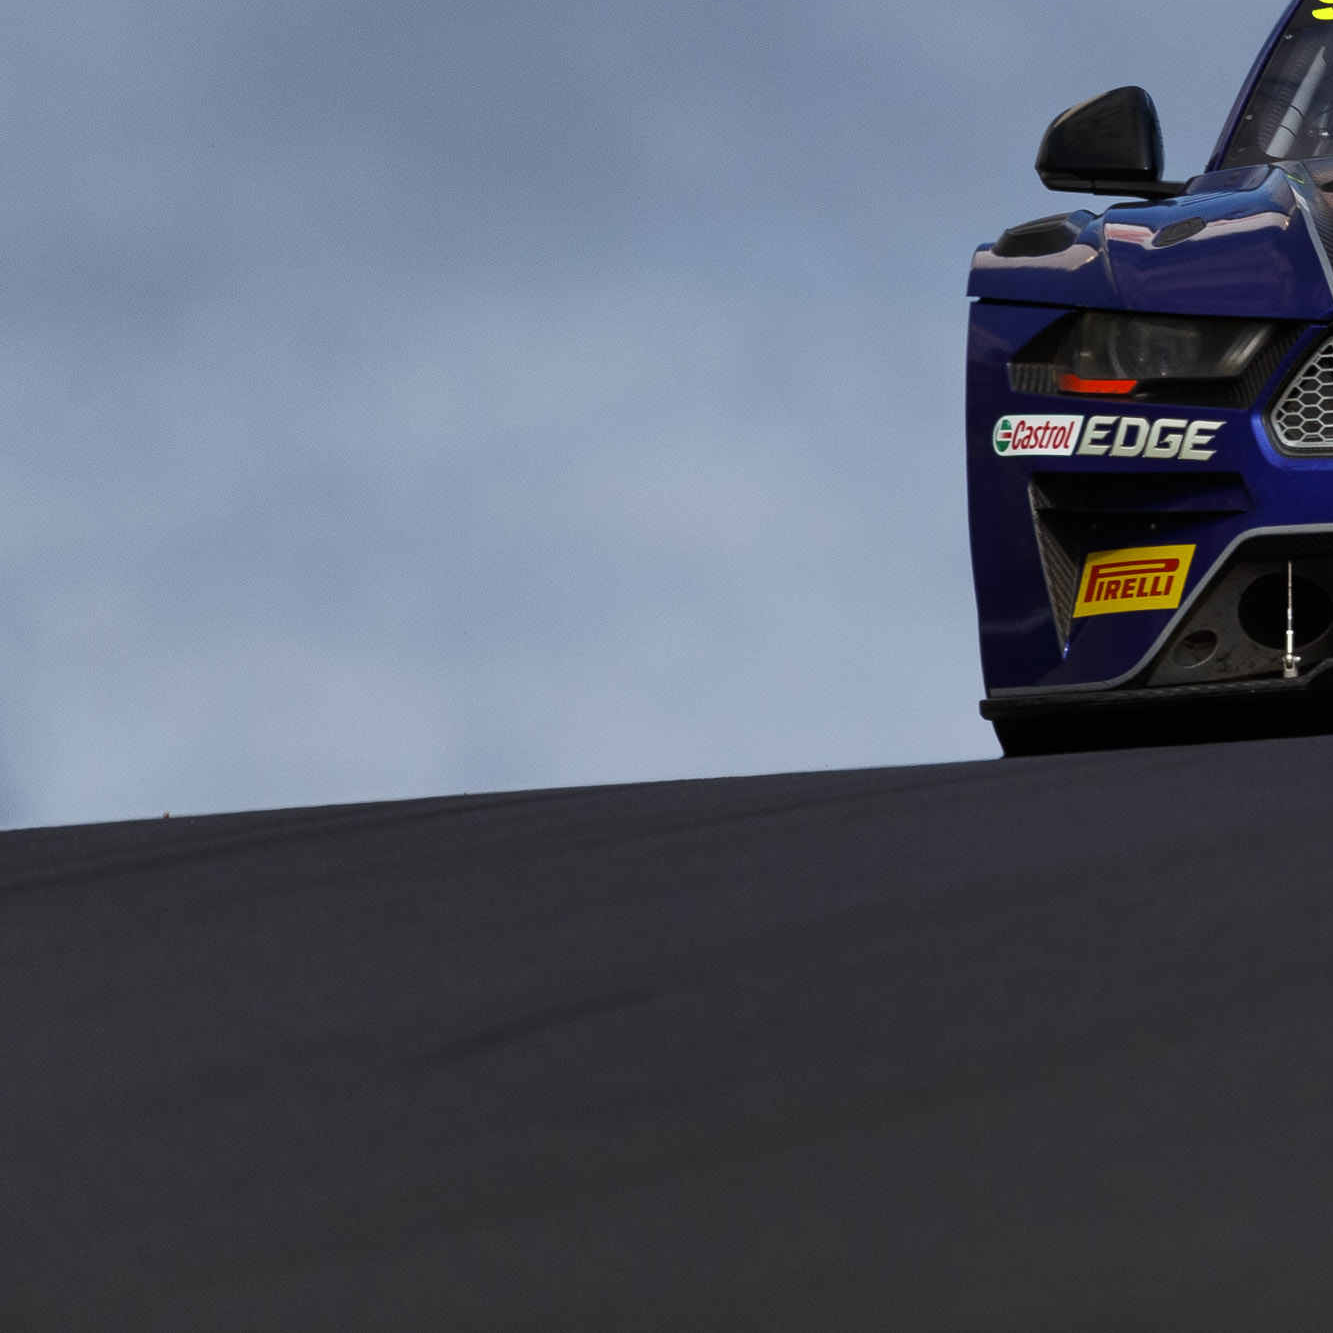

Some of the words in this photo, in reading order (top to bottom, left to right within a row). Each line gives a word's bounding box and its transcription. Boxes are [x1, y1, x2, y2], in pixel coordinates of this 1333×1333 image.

[1011, 419, 1075, 451] Castrol
[1076, 415, 1227, 461] EDGE
[1083, 557, 1180, 603] PIRELLI
